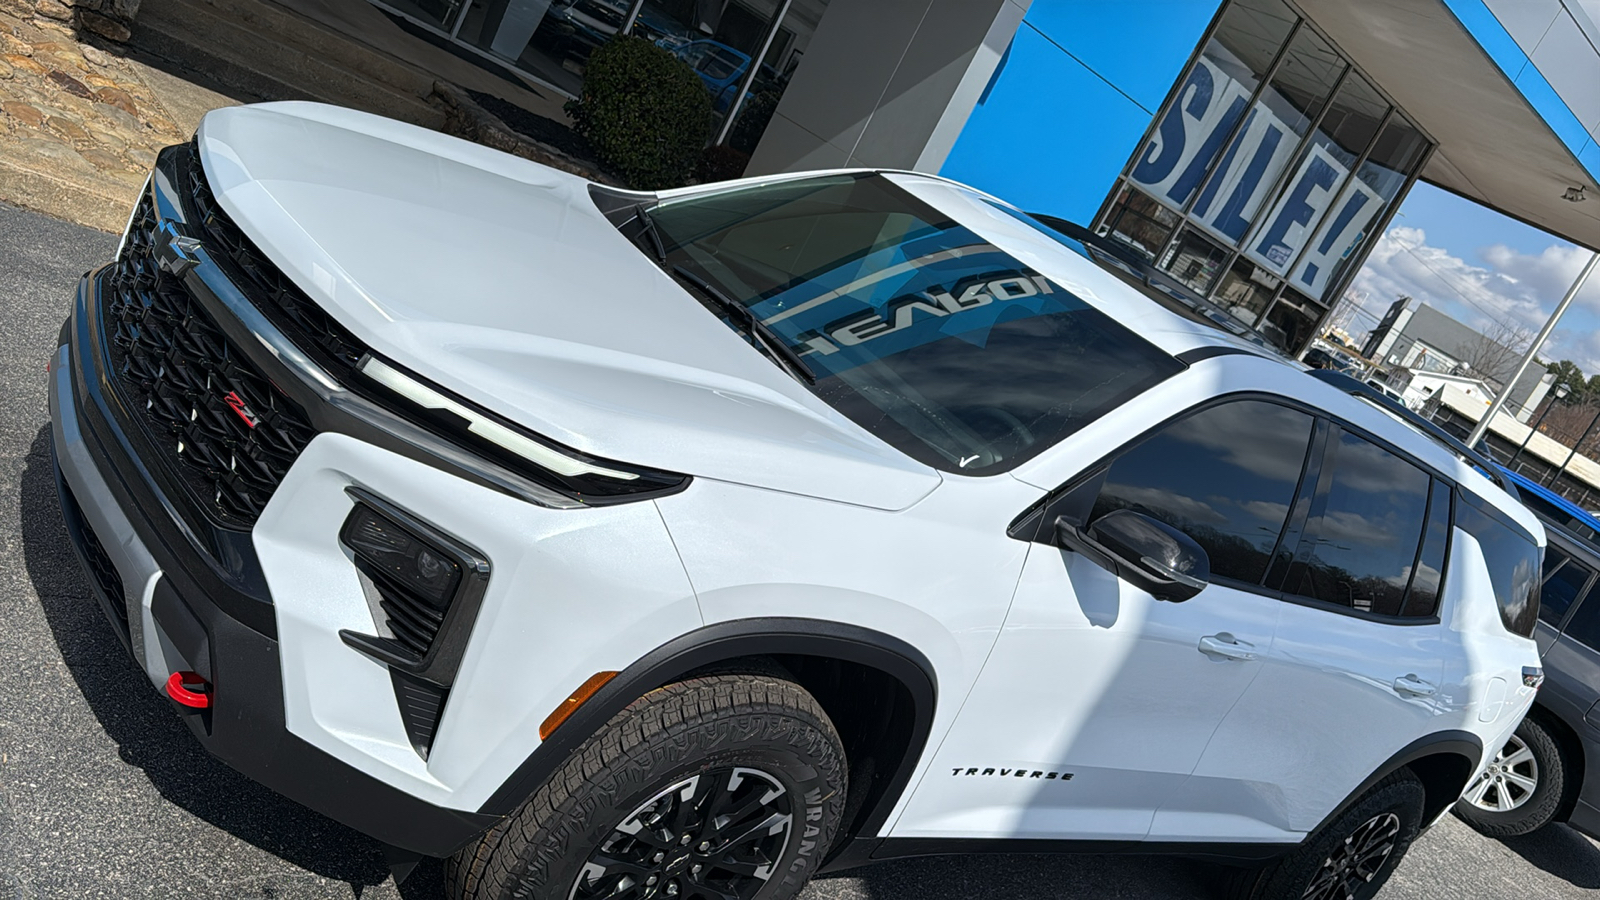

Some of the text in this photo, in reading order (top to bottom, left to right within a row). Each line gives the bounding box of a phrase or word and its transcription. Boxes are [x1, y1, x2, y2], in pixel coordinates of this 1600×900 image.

[1131, 60, 1370, 288] SALE!
[223, 390, 261, 428] Z71
[952, 767, 1074, 781] TRAVERSE
